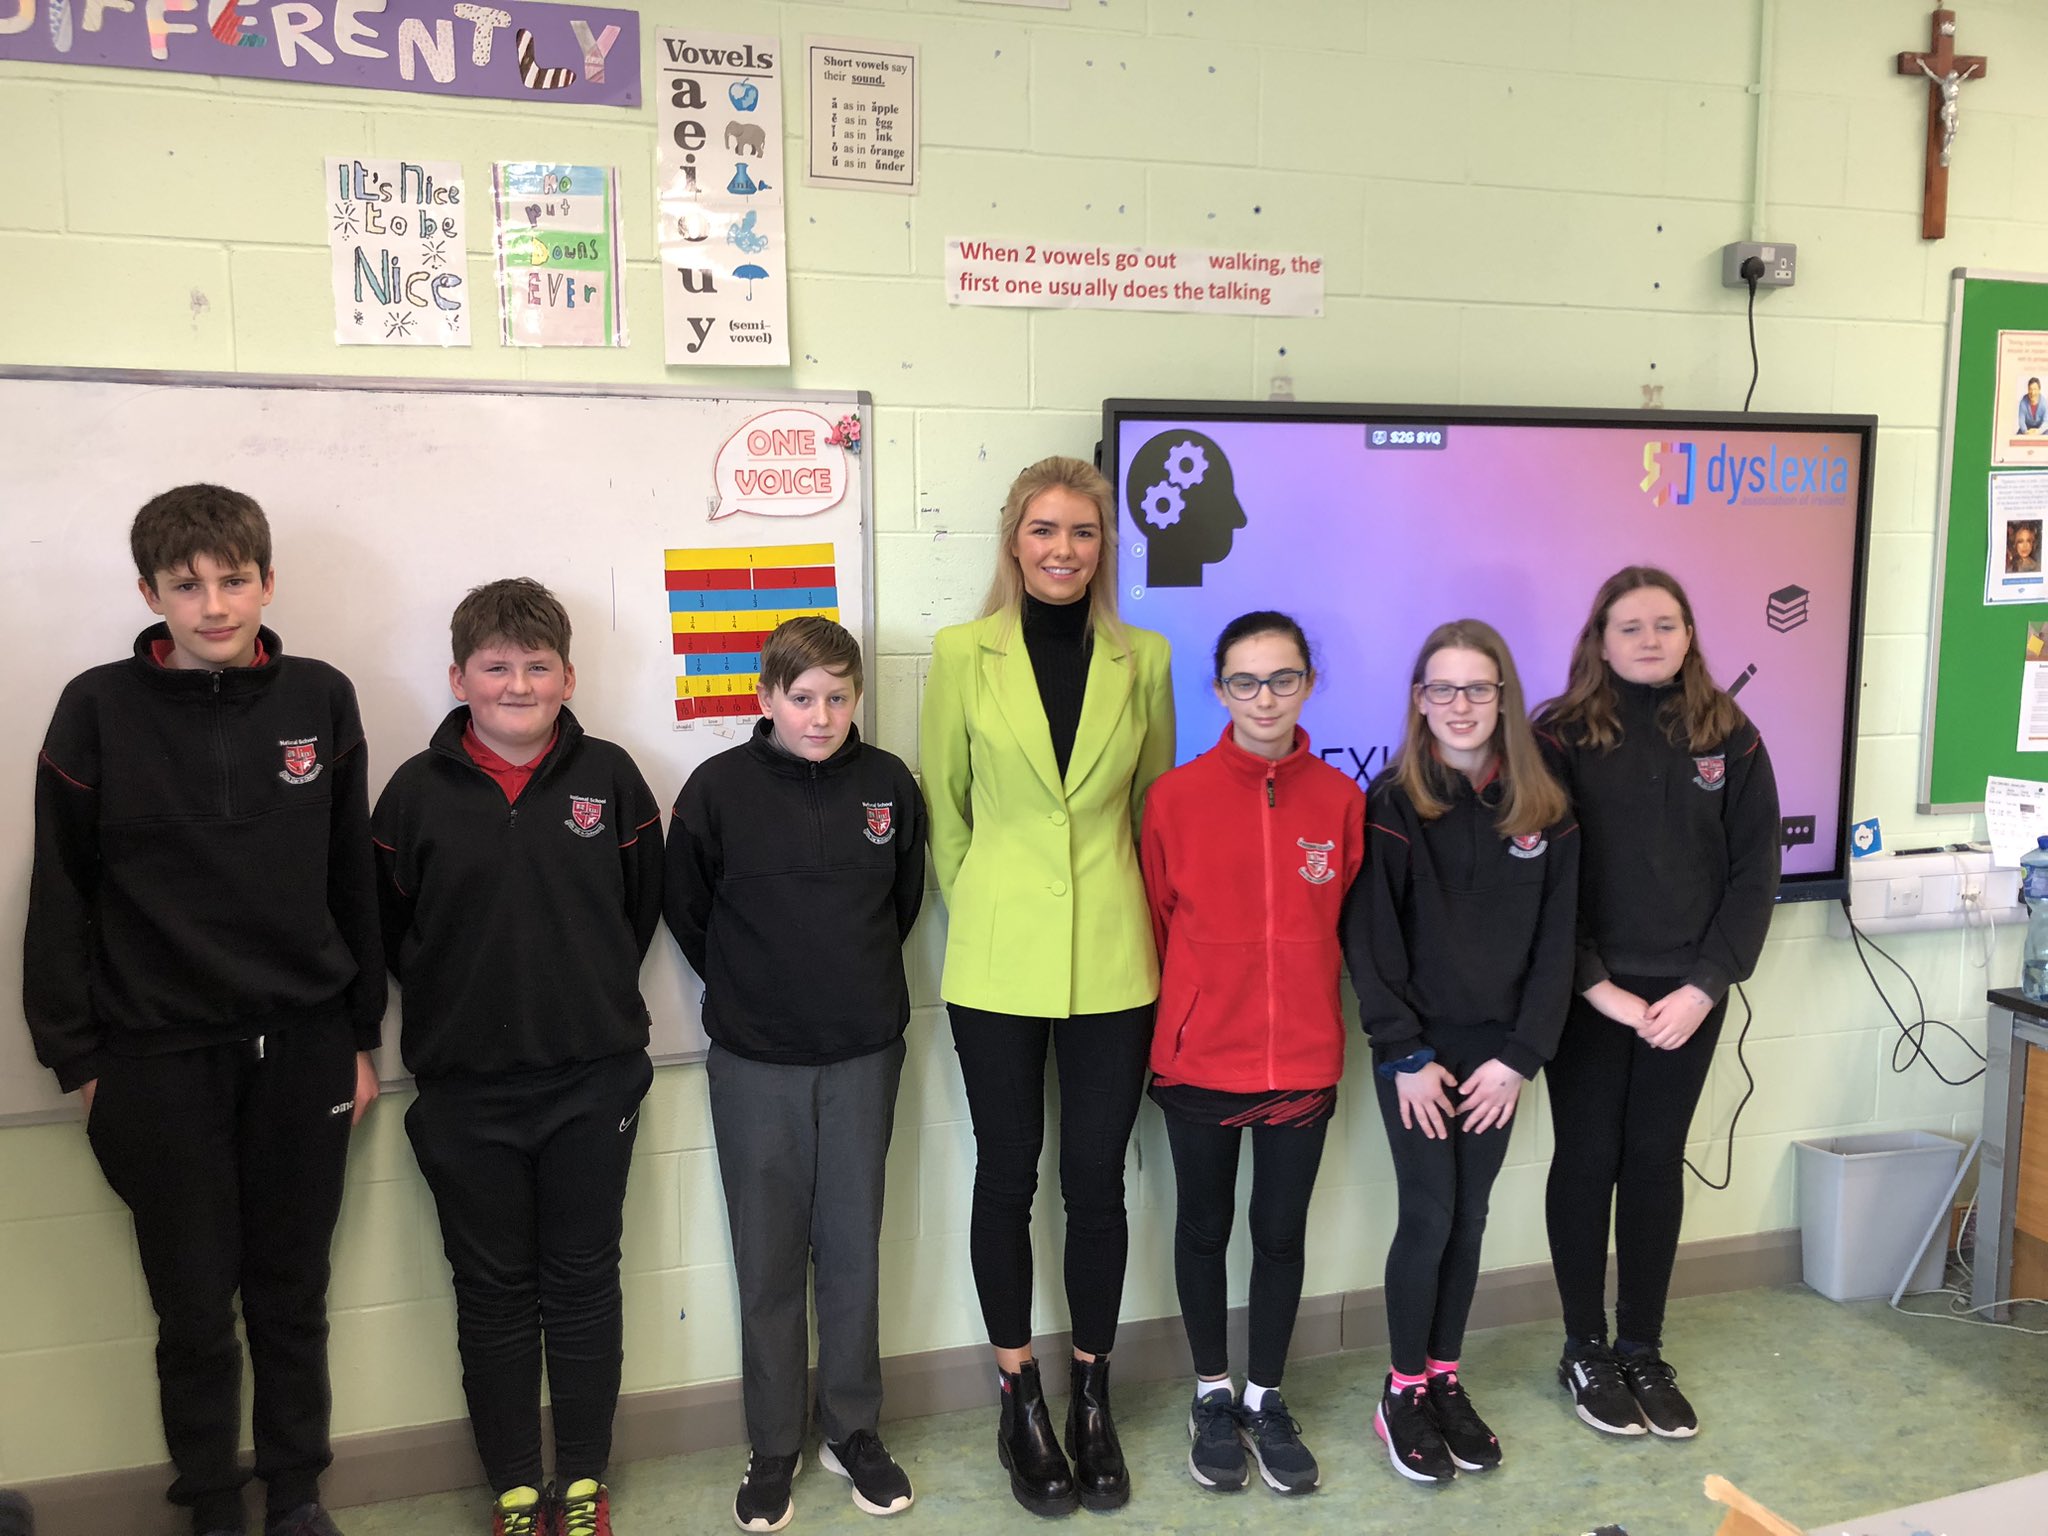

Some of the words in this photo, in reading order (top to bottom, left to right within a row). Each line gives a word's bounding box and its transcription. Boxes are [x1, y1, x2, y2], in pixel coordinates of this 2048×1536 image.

[663, 38, 773, 69] Vowels
[824, 56, 852, 68] Short
[856, 62, 889, 71] vowels
[892, 64, 907, 75] say
[824, 70, 846, 81] their
[852, 75, 885, 85] sound.
[671, 78, 707, 110] a
[857, 101, 866, 112] in
[857, 130, 866, 140] in
[858, 116, 867, 126] in
[673, 121, 706, 151] e
[857, 144, 866, 154] in
[844, 160, 854, 168] as
[857, 158, 866, 169] in
[338, 161, 392, 202] It's
[366, 202, 408, 236] to
[420, 210, 458, 238] be
[960, 242, 1019, 262] When
[1025, 246, 1036, 264] 2
[1042, 247, 1110, 266] vowels
[1116, 253, 1139, 271] go
[1144, 252, 1176, 269] out
[1208, 254, 1286, 276] walking,
[1292, 256, 1320, 274] the
[354, 246, 462, 310] Nice
[678, 268, 718, 294] u
[960, 272, 1000, 292] first
[1005, 278, 1042, 294] one
[1049, 276, 1117, 301] usually
[1124, 279, 1168, 298] does
[1174, 281, 1204, 300] the
[1208, 282, 1271, 305] talking
[686, 318, 716, 353] y
[729, 319, 771, 332] (semi-
[730, 332, 772, 345] vowel)
[748, 429, 816, 456] ONE
[734, 468, 832, 496] VOICE
[1707, 443, 1849, 505] dyslexia
